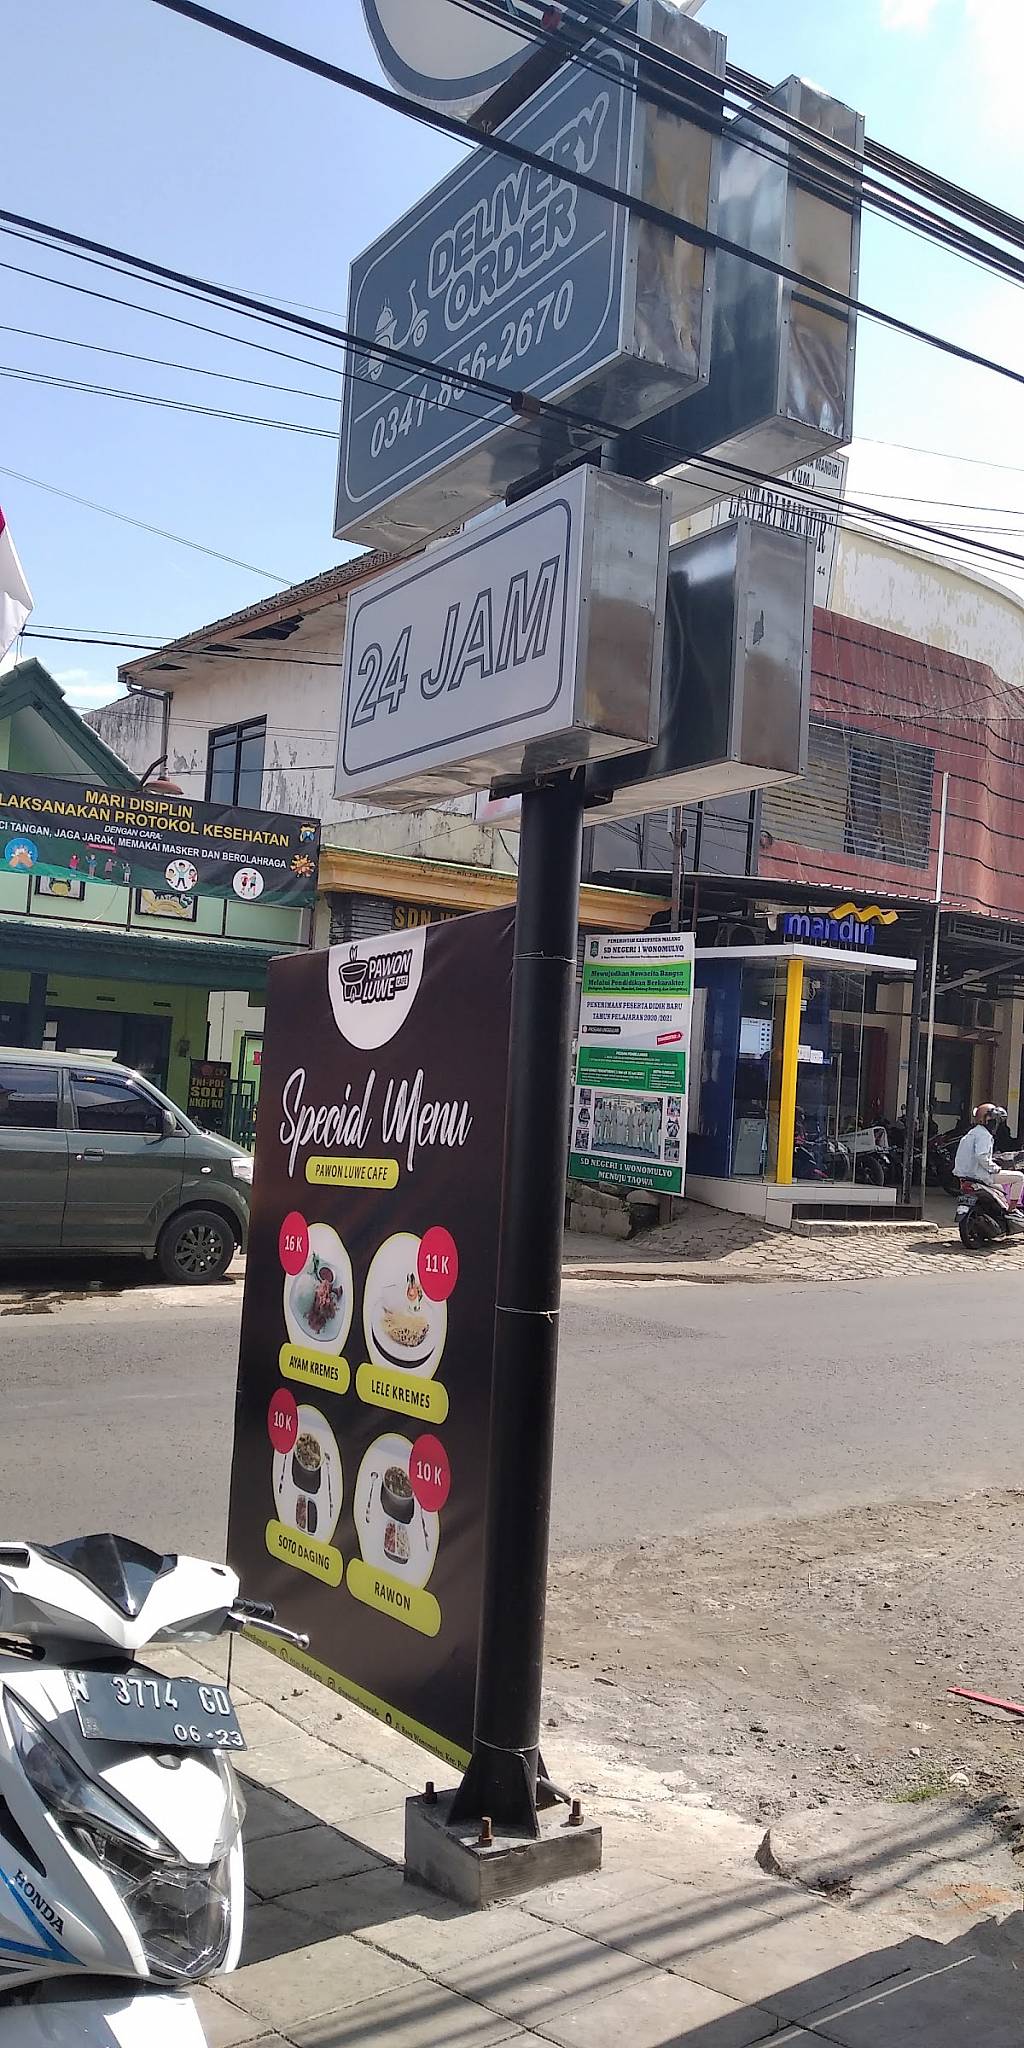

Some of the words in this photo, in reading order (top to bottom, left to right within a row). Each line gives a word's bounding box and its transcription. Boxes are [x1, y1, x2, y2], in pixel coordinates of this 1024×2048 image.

[428, 91, 609, 299] DELIVERY
[444, 184, 578, 331] ORDER
[371, 280, 574, 457] 0341-856-2670
[817, 566, 826, 575] 44
[351, 624, 412, 728] 24
[420, 554, 560, 700] JAM
[85, 790, 125, 808] MARI
[129, 797, 193, 818] DISIPLIN
[104, 825, 138, 837] DENGAN
[139, 830, 163, 840] CARA:
[115, 810, 199, 835] PROTOKOL
[203, 823, 289, 847] KESEHATAN
[10, 822, 52, 838] TANGAN,
[54, 828, 80, 841] JAGA
[82, 832, 116, 846] JARAK,
[118, 837, 161, 852] MEMAKAI
[162, 844, 199, 858] MASKER
[201, 849, 220, 860] DAN
[222, 852, 287, 869] BEROLAHRAGA
[394, 905, 431, 929] SDN
[784, 912, 876, 945] mandiri
[603, 946, 612, 954] SD
[642, 945, 684, 953] WONOMULYO
[368, 950, 412, 980] PAWON
[361, 977, 395, 1001] LUWE
[189, 1097, 210, 1108] NKRI
[279, 1067, 376, 1178] Special
[382, 1068, 473, 1172] Menu
[315, 1163, 343, 1178] PAWON
[344, 1166, 366, 1179] LUWE
[367, 1166, 389, 1181] CAFE
[580, 1157, 590, 1165] SD
[591, 1159, 618, 1170] NEGERI
[624, 1164, 673, 1177] WONOMULYO
[284, 1235, 295, 1251] 16
[296, 1236, 303, 1253] K
[425, 1254, 438, 1273] 11
[441, 1257, 449, 1275] K
[289, 1355, 309, 1374] AYAM
[309, 1359, 339, 1381] KREMES
[371, 1379, 390, 1398] LELE
[392, 1386, 430, 1409] KREMES
[273, 1411, 284, 1428] 10
[285, 1414, 292, 1431] K
[416, 1460, 429, 1482] 10
[434, 1467, 442, 1486] K
[278, 1534, 297, 1554] SOTO
[297, 1544, 330, 1570] DAGING
[374, 1581, 411, 1611] RAWON
[111, 1676, 179, 1711] 3774
[198, 1686, 231, 1716] GD
[13, 1868, 65, 1937] HONDA
